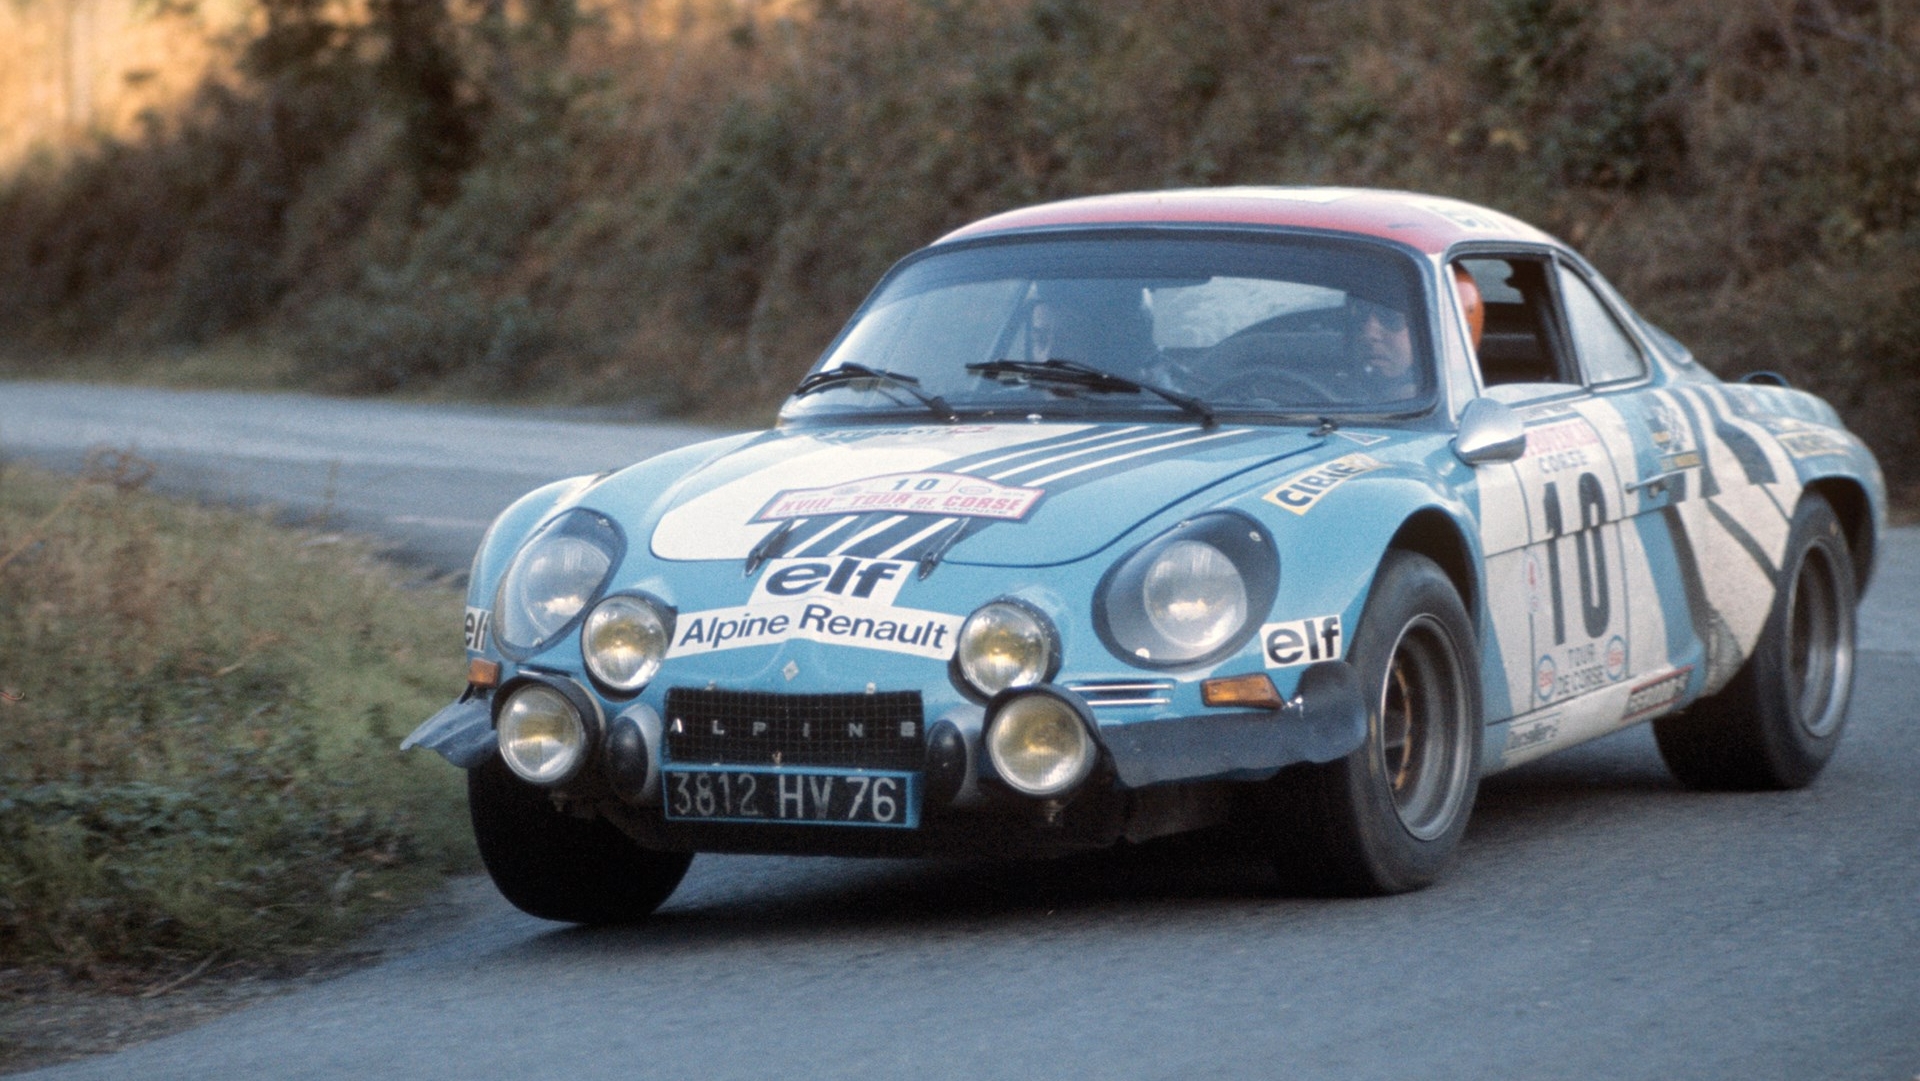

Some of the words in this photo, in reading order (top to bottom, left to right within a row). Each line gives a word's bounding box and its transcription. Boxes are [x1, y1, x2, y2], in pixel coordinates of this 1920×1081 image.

[850, 491, 914, 506] TOUR
[942, 494, 1024, 511] CORSE
[891, 478, 941, 491] 10
[765, 557, 902, 599] elf
[1543, 472, 1611, 646] 10
[465, 611, 494, 651] elf
[679, 612, 790, 649] Alpine
[798, 603, 949, 650] Renault
[1266, 616, 1340, 665] elf
[670, 717, 917, 738] ALPINE
[672, 772, 760, 816] 3812
[778, 774, 834, 819] HV
[846, 776, 897, 823] 76
